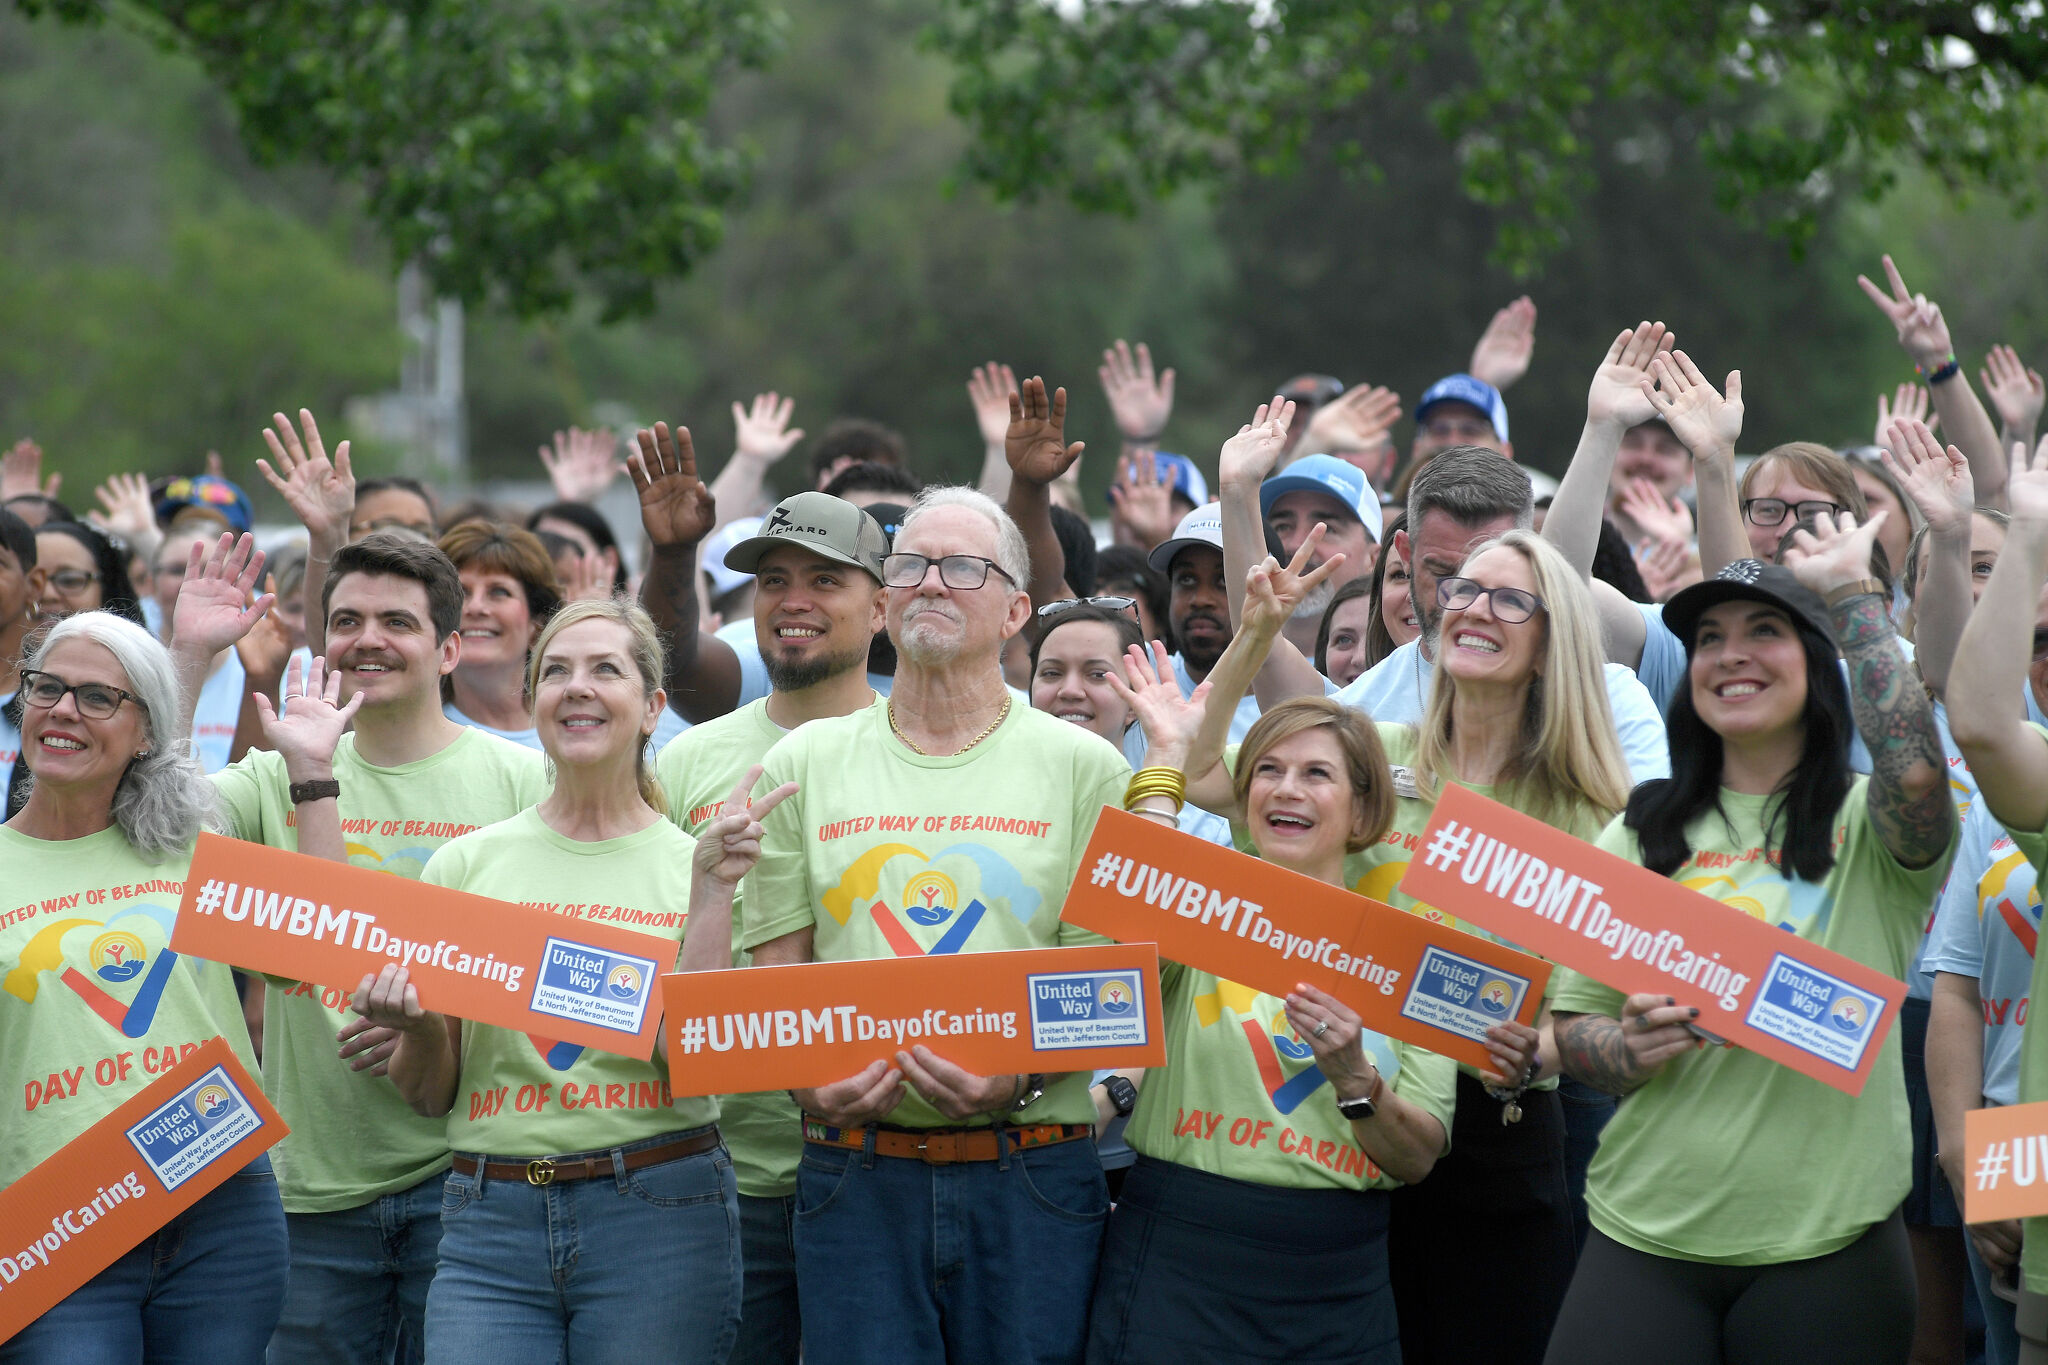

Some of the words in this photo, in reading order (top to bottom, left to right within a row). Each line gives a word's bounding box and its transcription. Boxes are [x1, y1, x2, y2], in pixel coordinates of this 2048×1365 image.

[341, 818, 378, 834] WAY
[380, 820, 402, 837] OF
[819, 816, 874, 842] UNITED
[878, 816, 919, 832] WAY
[924, 816, 946, 832] OF
[950, 815, 1052, 838] BEAUMONT
[1696, 850, 1738, 869] WAY
[0, 904, 37, 932] ITED
[40, 893, 80, 914] WAY
[86, 888, 106, 904] OF
[112, 880, 187, 900] BEAUMO
[588, 904, 688, 928] BEAUMONT
[1424, 820, 1750, 1012] #UWBMTDayofCaring
[195, 879, 524, 992] #UWBMTDayofCaring
[1090, 852, 1401, 996] #UWBMTDayofCaring
[552, 949, 604, 974] United
[1429, 958, 1480, 987] United
[569, 970, 600, 993] Way
[1037, 982, 1092, 1000] United
[1443, 980, 1473, 1005] Way
[1777, 966, 1832, 1002] United
[538, 998, 544, 1006] &
[545, 1001, 568, 1012] North
[568, 1006, 606, 1021] Jefferson
[608, 1015, 635, 1028] County
[540, 990, 566, 1002] United
[567, 996, 582, 1006] Way
[594, 1003, 634, 1018] Beaumont
[1060, 1000, 1092, 1018] Way
[1413, 996, 1437, 1010] United
[1438, 1006, 1454, 1016] Way
[1466, 1014, 1490, 1028] Beaum
[1791, 991, 1824, 1020] Way
[681, 1006, 1017, 1054] #UWBMTDayofCaring
[1039, 1026, 1064, 1035] United
[1066, 1026, 1083, 1034] Way
[1096, 1024, 1136, 1032] Beaumont
[1417, 1008, 1437, 1020] North
[1439, 1016, 1474, 1033] Jefferson
[1759, 1006, 1785, 1022] United
[1786, 1016, 1802, 1030] Way
[1804, 1024, 1813, 1034] of
[1814, 1029, 1854, 1053] Beaumont
[1048, 1034, 1070, 1044] North
[1072, 1033, 1110, 1043] Jefferson
[1112, 1032, 1140, 1041] County
[1763, 1018, 1784, 1032] North
[1786, 1028, 1823, 1050] Jefferson
[1824, 1045, 1852, 1064] County
[24, 1066, 84, 1112] DAY
[94, 1051, 134, 1086] OF
[469, 1086, 509, 1122] DAY
[514, 1083, 552, 1112] OF
[139, 1104, 191, 1146] United
[166, 1120, 200, 1146] Way
[1228, 1117, 1274, 1149] OF
[162, 1156, 186, 1176] United
[185, 1146, 202, 1159] Way
[202, 1136, 211, 1148] of
[210, 1113, 246, 1142] Beaumont
[174, 1164, 196, 1180] North
[196, 1138, 230, 1164] Jefferson
[228, 1118, 254, 1139] County
[0, 1171, 146, 1293] DayofCaring
